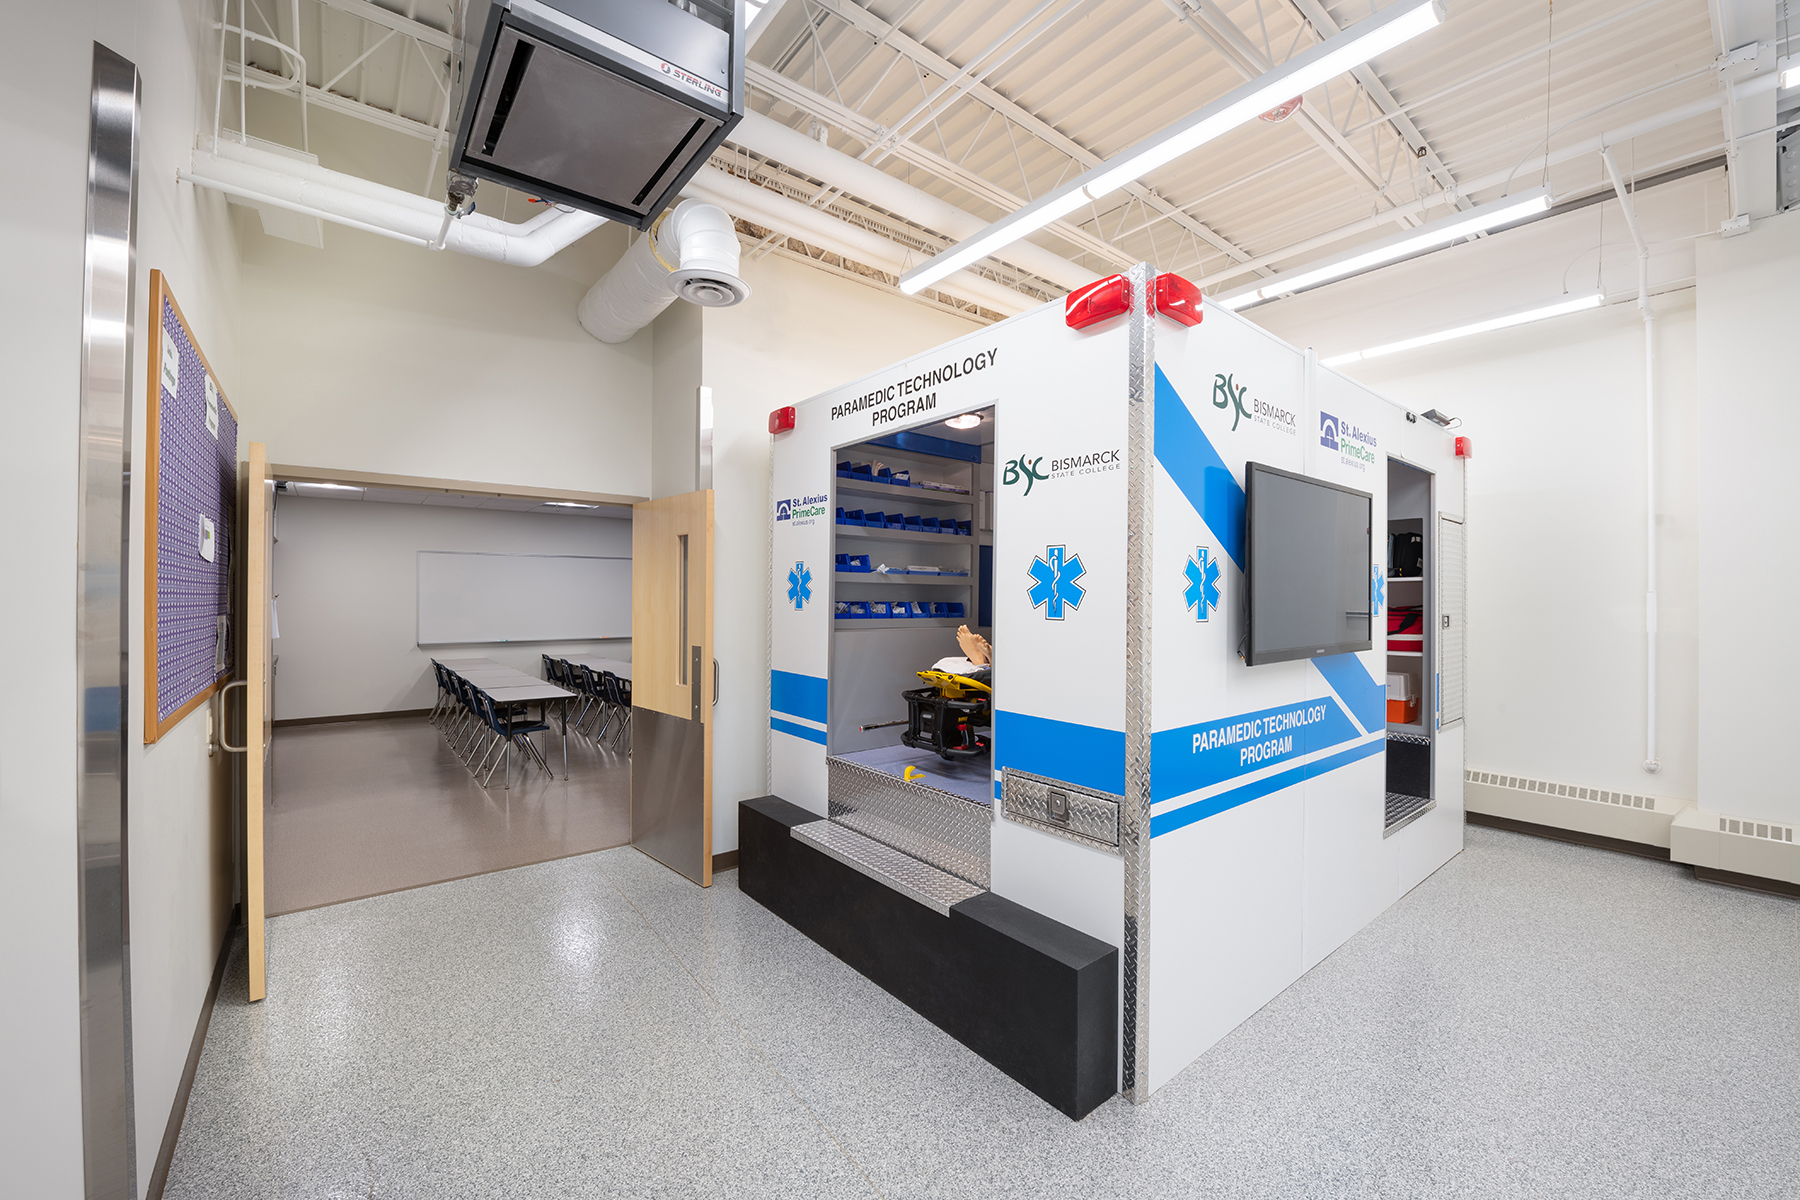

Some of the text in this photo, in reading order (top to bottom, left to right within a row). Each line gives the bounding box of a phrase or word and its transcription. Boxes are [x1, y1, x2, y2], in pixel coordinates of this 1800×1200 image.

[673, 69, 722, 97] STERLING
[831, 348, 998, 420] PARAMEDIC TECHNOLOGY
[872, 393, 936, 427] PROGRAM
[1254, 399, 1296, 427] BISMARCK
[1254, 416, 1296, 436] STATE COLLEGE
[1341, 421, 1377, 447] St. Alexius
[1052, 449, 1120, 472] BISMARCK
[1341, 438, 1375, 464] PrimeCare
[1051, 463, 1120, 479] STATE COLLEGE
[792, 494, 828, 507] St. Alexius
[792, 506, 826, 519] PrimeCare
[1193, 705, 1327, 754] PARAMEDIC TECHNOLOGY
[1240, 735, 1292, 767] PROGRAM
